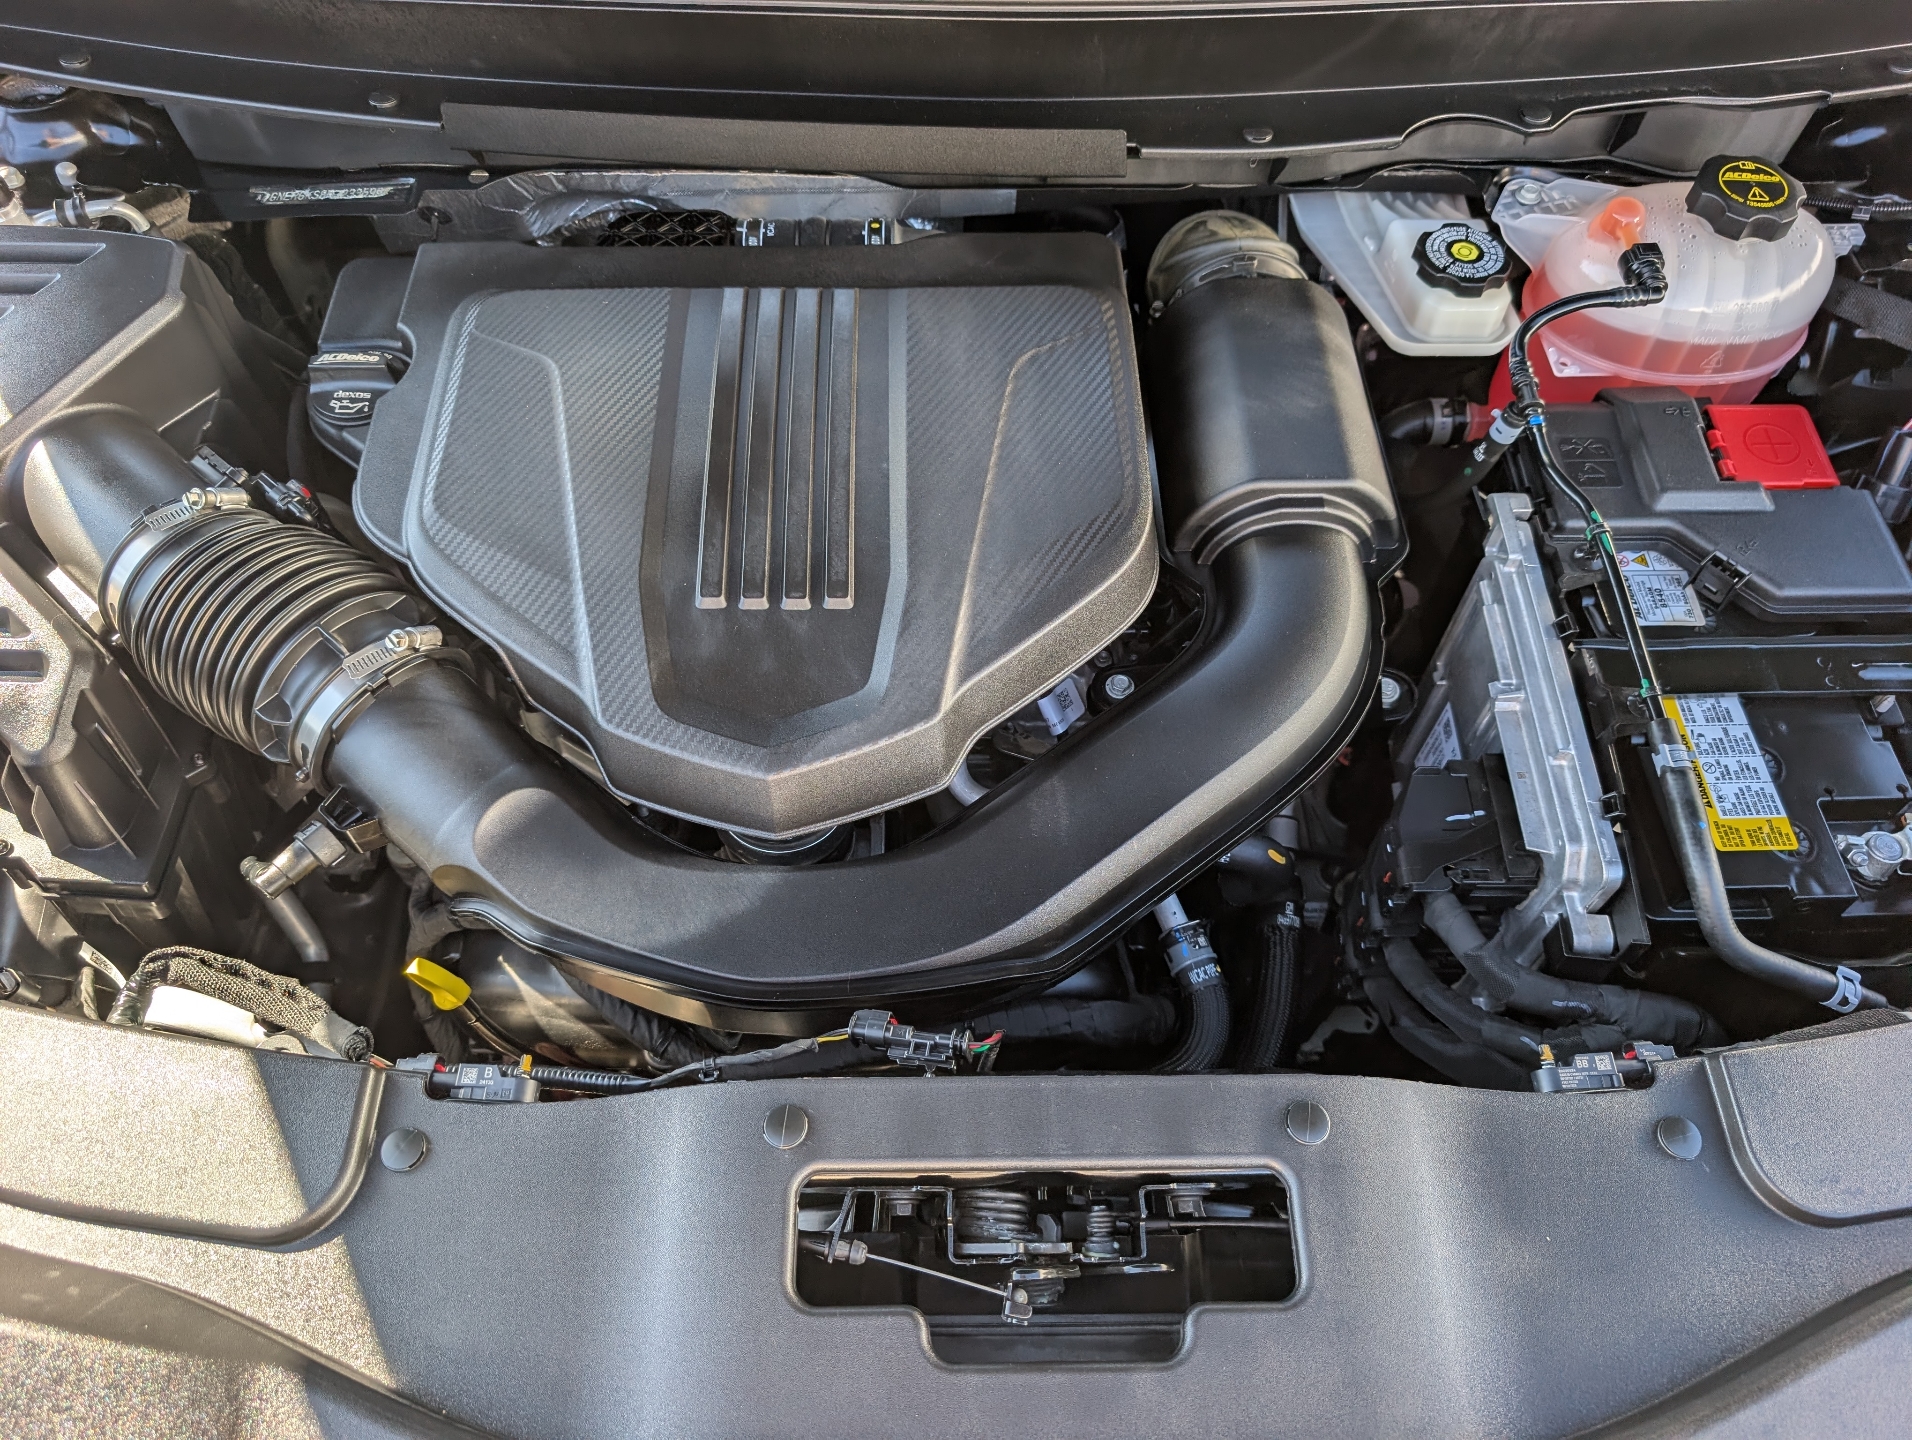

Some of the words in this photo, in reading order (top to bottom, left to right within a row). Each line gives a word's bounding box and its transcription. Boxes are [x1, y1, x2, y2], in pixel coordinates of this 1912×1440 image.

[1722, 171, 1780, 182] ACDelco
[317, 353, 380, 362] ACDelco
[333, 390, 371, 399] dexos
[1654, 588, 1667, 608] 8540
[1576, 1059, 1589, 1068] BB
[484, 1067, 493, 1078] B
